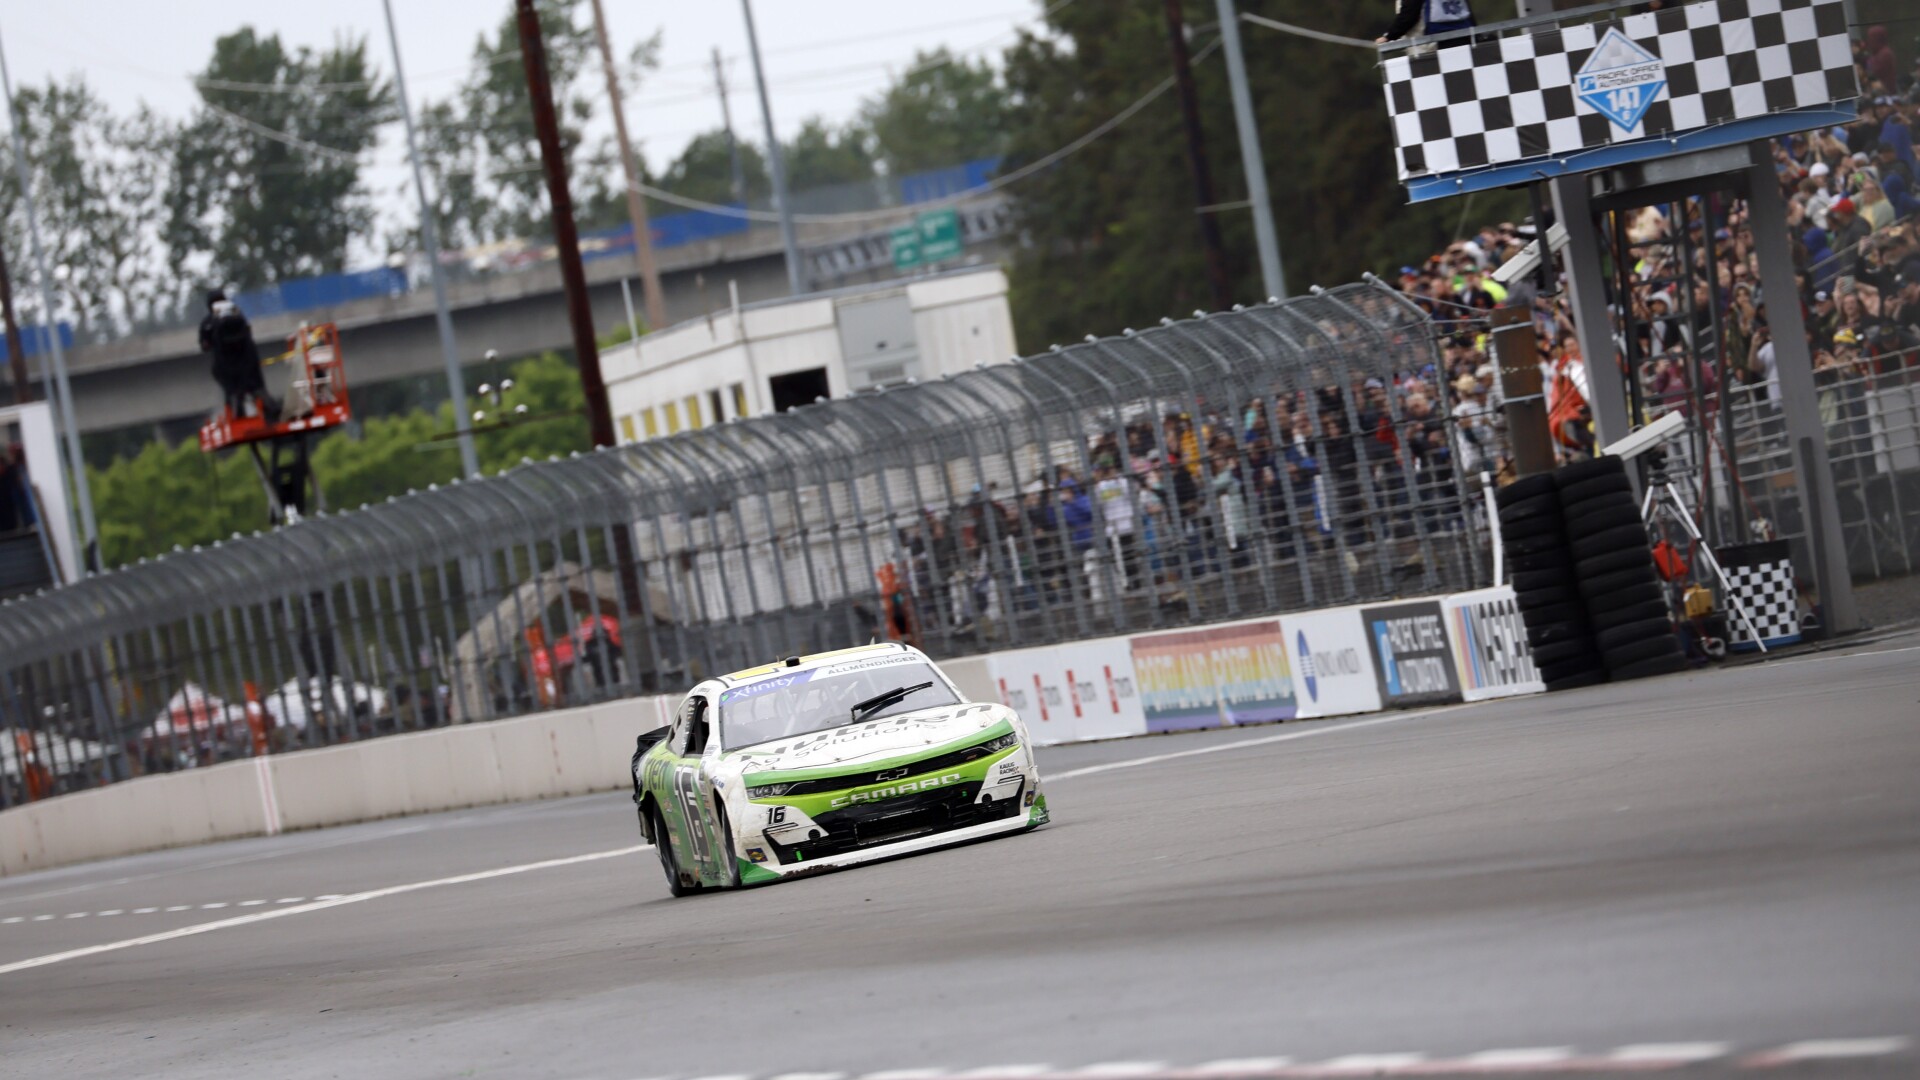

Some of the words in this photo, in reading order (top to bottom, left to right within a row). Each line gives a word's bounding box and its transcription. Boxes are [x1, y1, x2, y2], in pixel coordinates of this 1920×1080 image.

[1597, 69, 1628, 80] PACIFIC
[1630, 63, 1660, 74] OFFICE
[1600, 73, 1655, 88] AUTOMATION
[1605, 86, 1641, 113] 147
[733, 676, 797, 699] xfinity
[828, 656, 917, 675] ALLMENDINGER
[830, 773, 961, 809] CAMARO
[674, 764, 711, 862] 16
[766, 805, 787, 826] 16
